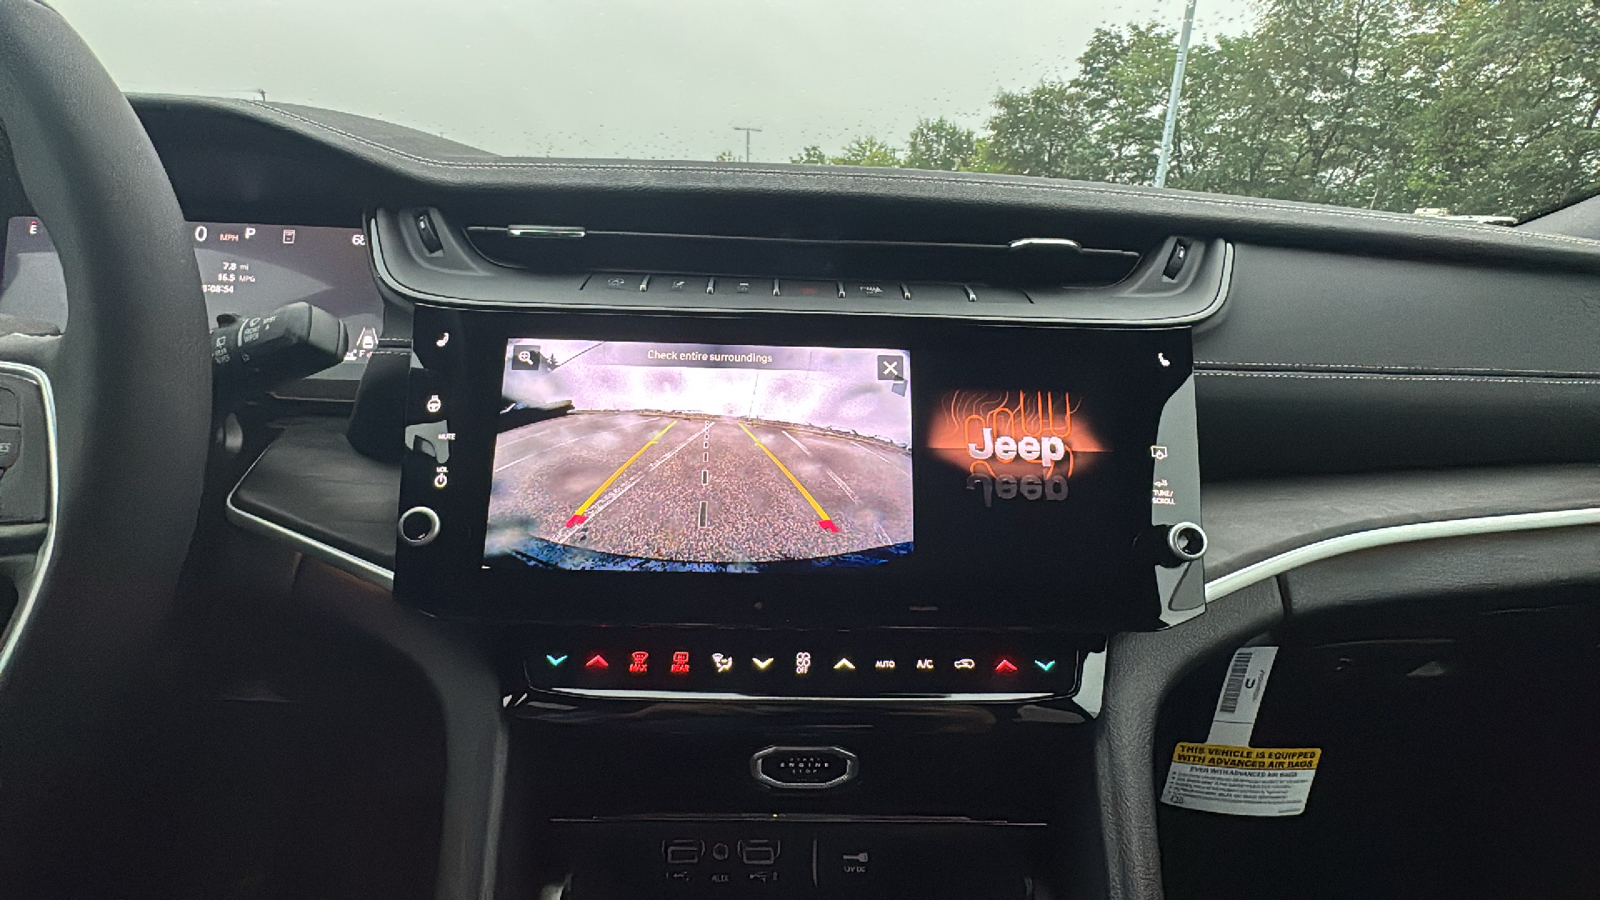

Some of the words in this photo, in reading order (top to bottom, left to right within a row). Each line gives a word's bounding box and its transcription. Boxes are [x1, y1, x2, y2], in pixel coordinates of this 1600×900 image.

[29, 224, 38, 235] E
[194, 225, 208, 242] 0
[219, 233, 239, 242] MPH
[244, 227, 257, 239] P
[239, 275, 256, 283] MPG
[647, 349, 678, 361] Check
[679, 351, 708, 361] entire
[709, 352, 773, 364] surroundings
[967, 427, 1066, 468] Jeep
[1151, 497, 1176, 506] SCROLL
[629, 663, 648, 673] MAX
[670, 664, 690, 673] REAR
[875, 660, 896, 668] AUTO
[916, 659, 934, 669] A/C
[796, 666, 809, 674] OFF
[1179, 744, 1205, 755] THIS
[1208, 747, 1253, 759] VEHICLE
[1256, 750, 1265, 759] IS
[1268, 751, 1317, 760] EQUIPPED
[1177, 753, 1206, 764] WITH
[1208, 757, 1266, 768] ADVANCED
[1268, 760, 1285, 769] AIR
[1287, 760, 1313, 768] BAGS
[1210, 768, 1228, 776] WITH
[1228, 769, 1266, 778] ADVANCED
